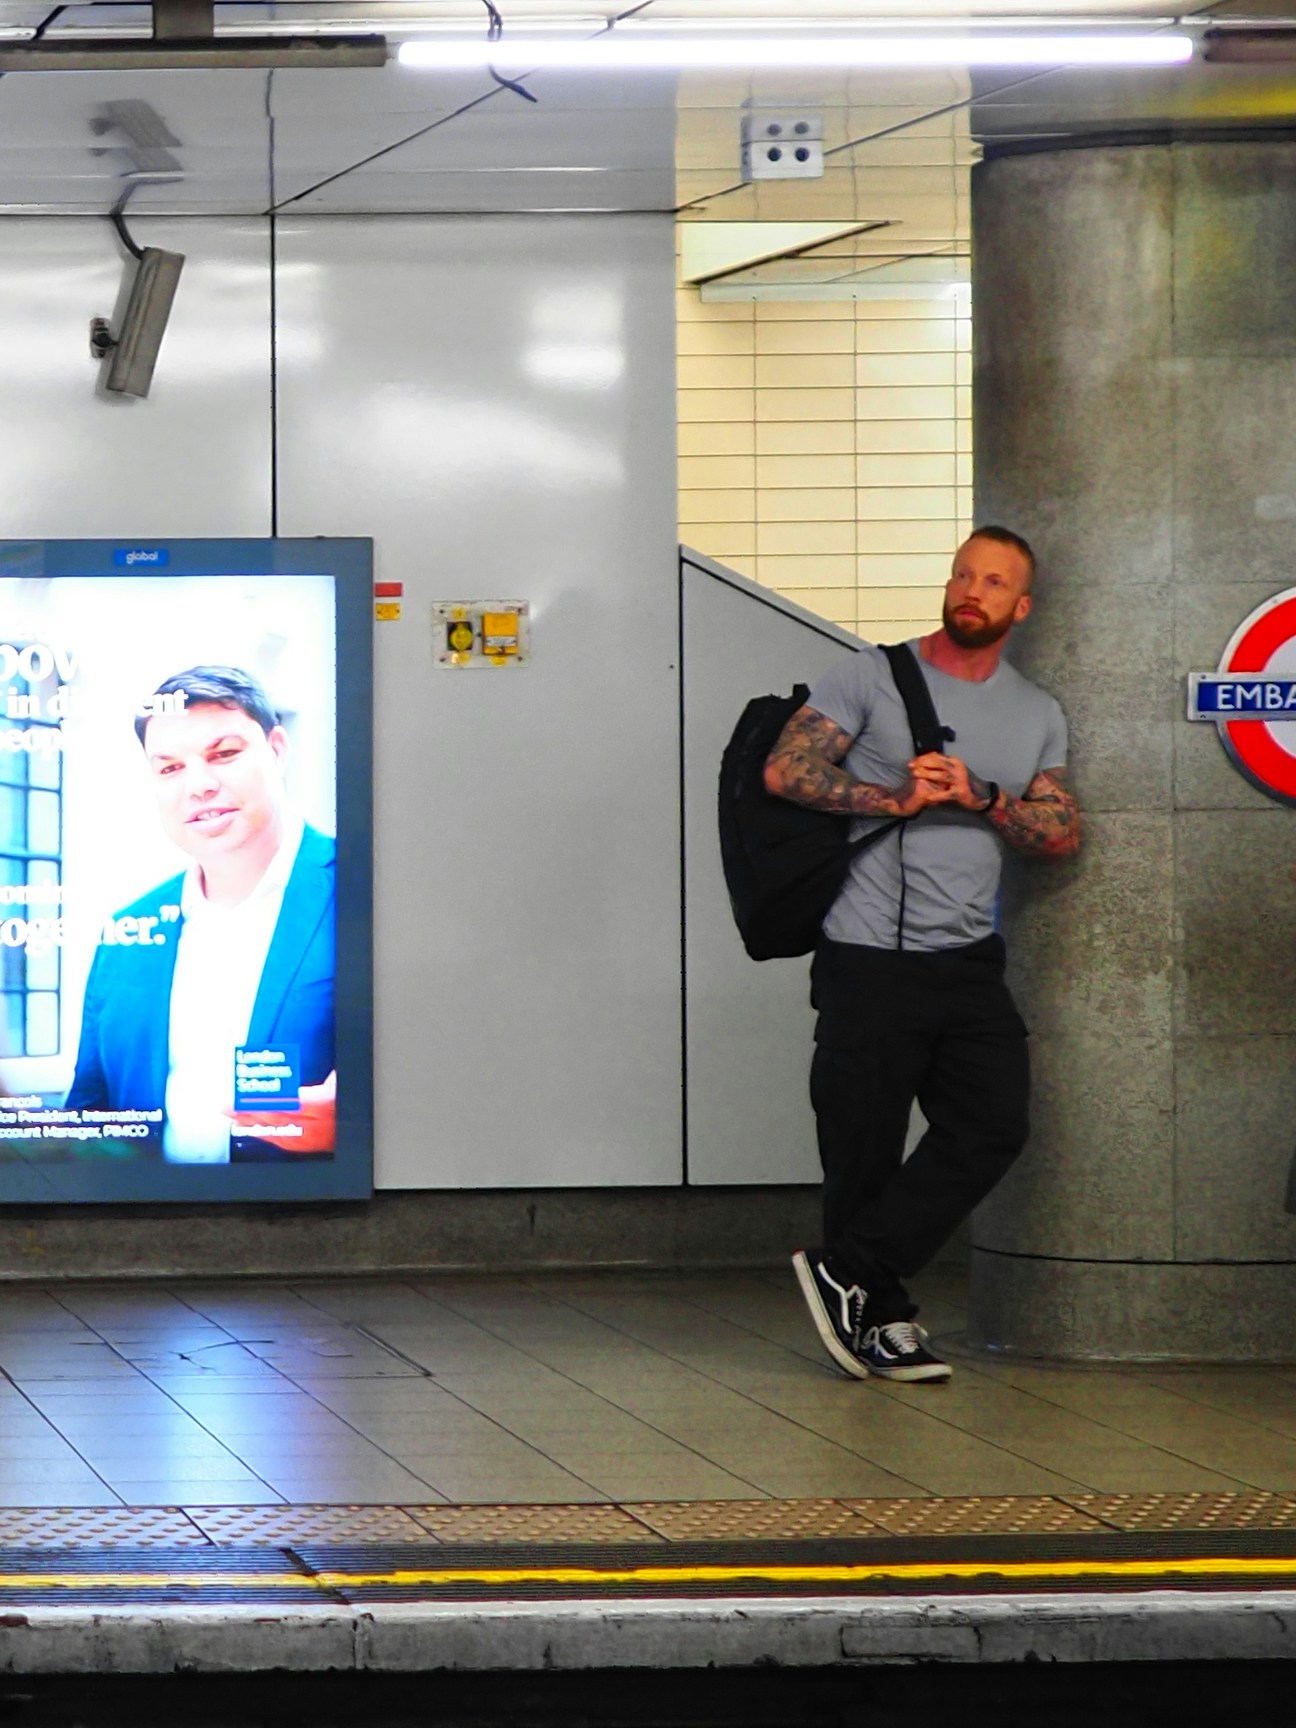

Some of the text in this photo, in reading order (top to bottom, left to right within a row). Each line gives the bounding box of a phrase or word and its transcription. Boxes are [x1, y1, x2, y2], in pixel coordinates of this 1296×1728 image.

[6, 685, 41, 719] in
[1216, 683, 1296, 710] EMBA
[236, 1049, 286, 1064] London
[236, 1064, 293, 1078] Business
[236, 1077, 281, 1093] School
[81, 1108, 163, 1122] International
[102, 1124, 149, 1138] PIMCO
